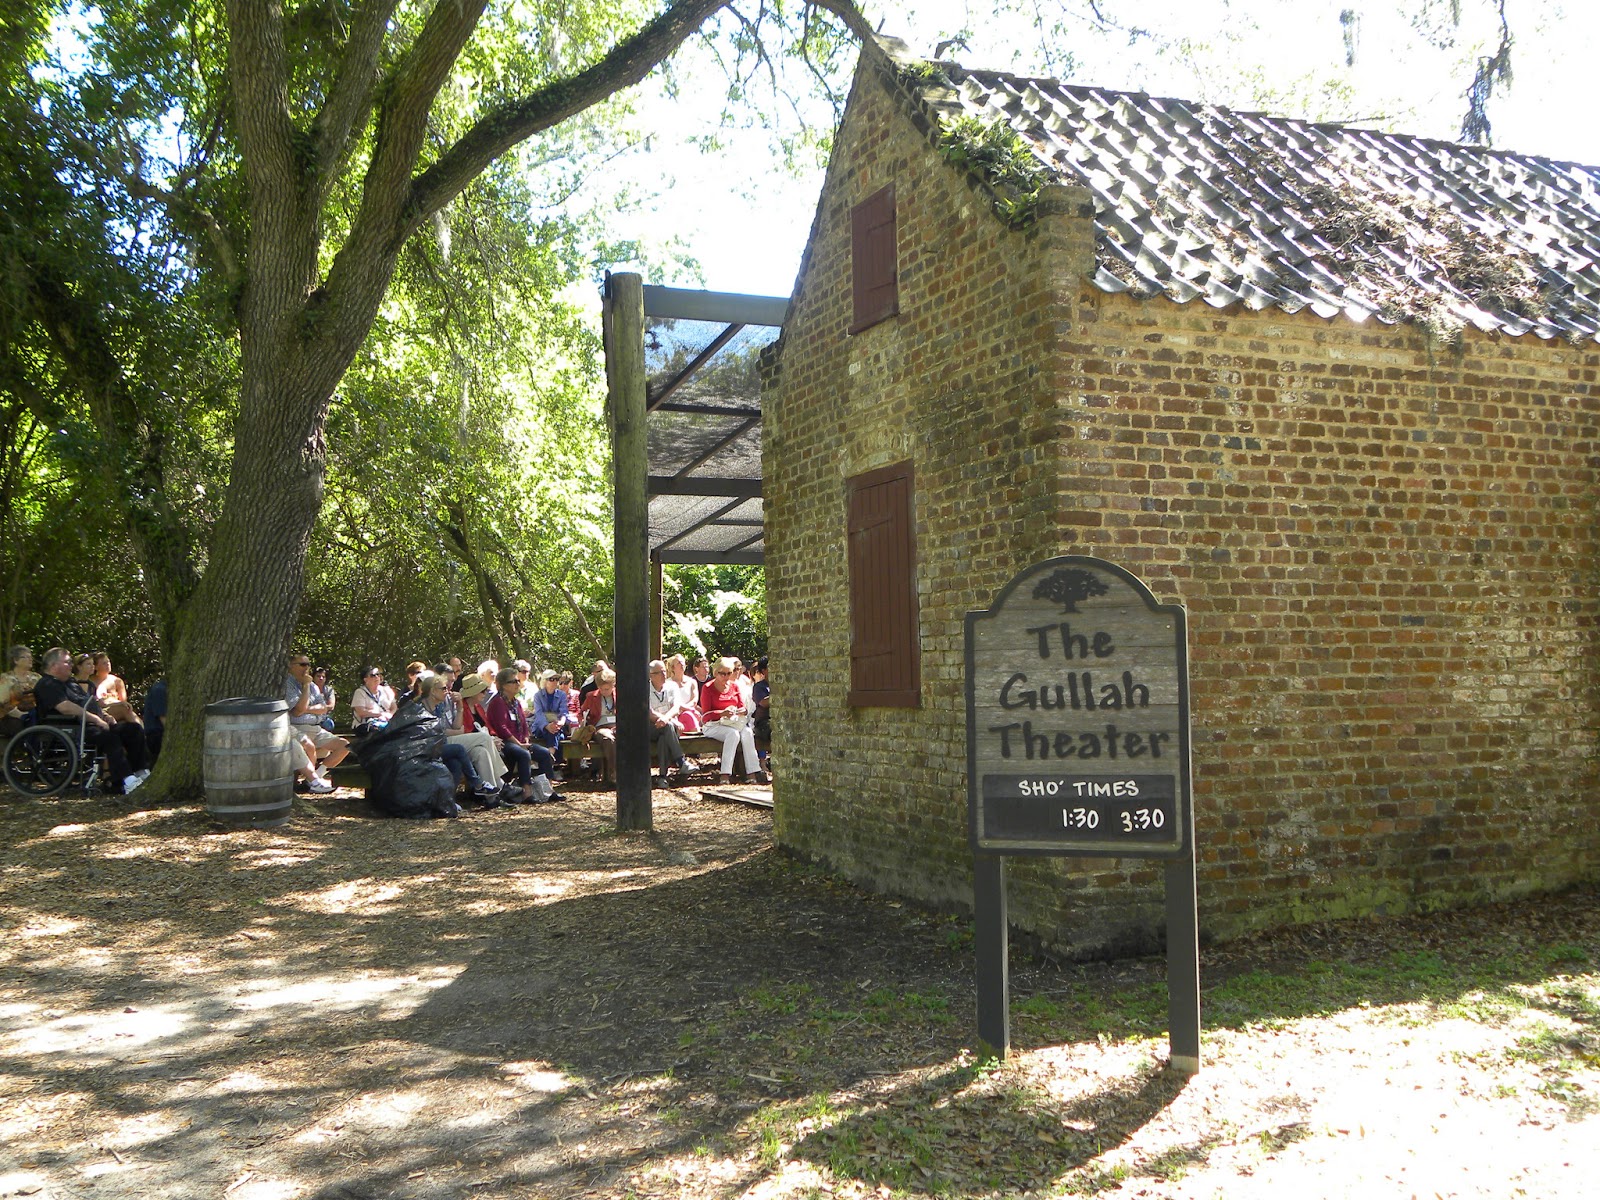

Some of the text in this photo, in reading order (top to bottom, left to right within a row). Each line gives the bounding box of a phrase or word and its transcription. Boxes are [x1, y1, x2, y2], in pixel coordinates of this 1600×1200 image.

[1026, 622, 1115, 660] The
[999, 671, 1150, 711] Gullah
[988, 721, 1169, 760] Theater
[1073, 780, 1139, 797] TIMES
[1062, 808, 1165, 832] 1:30 3:30
